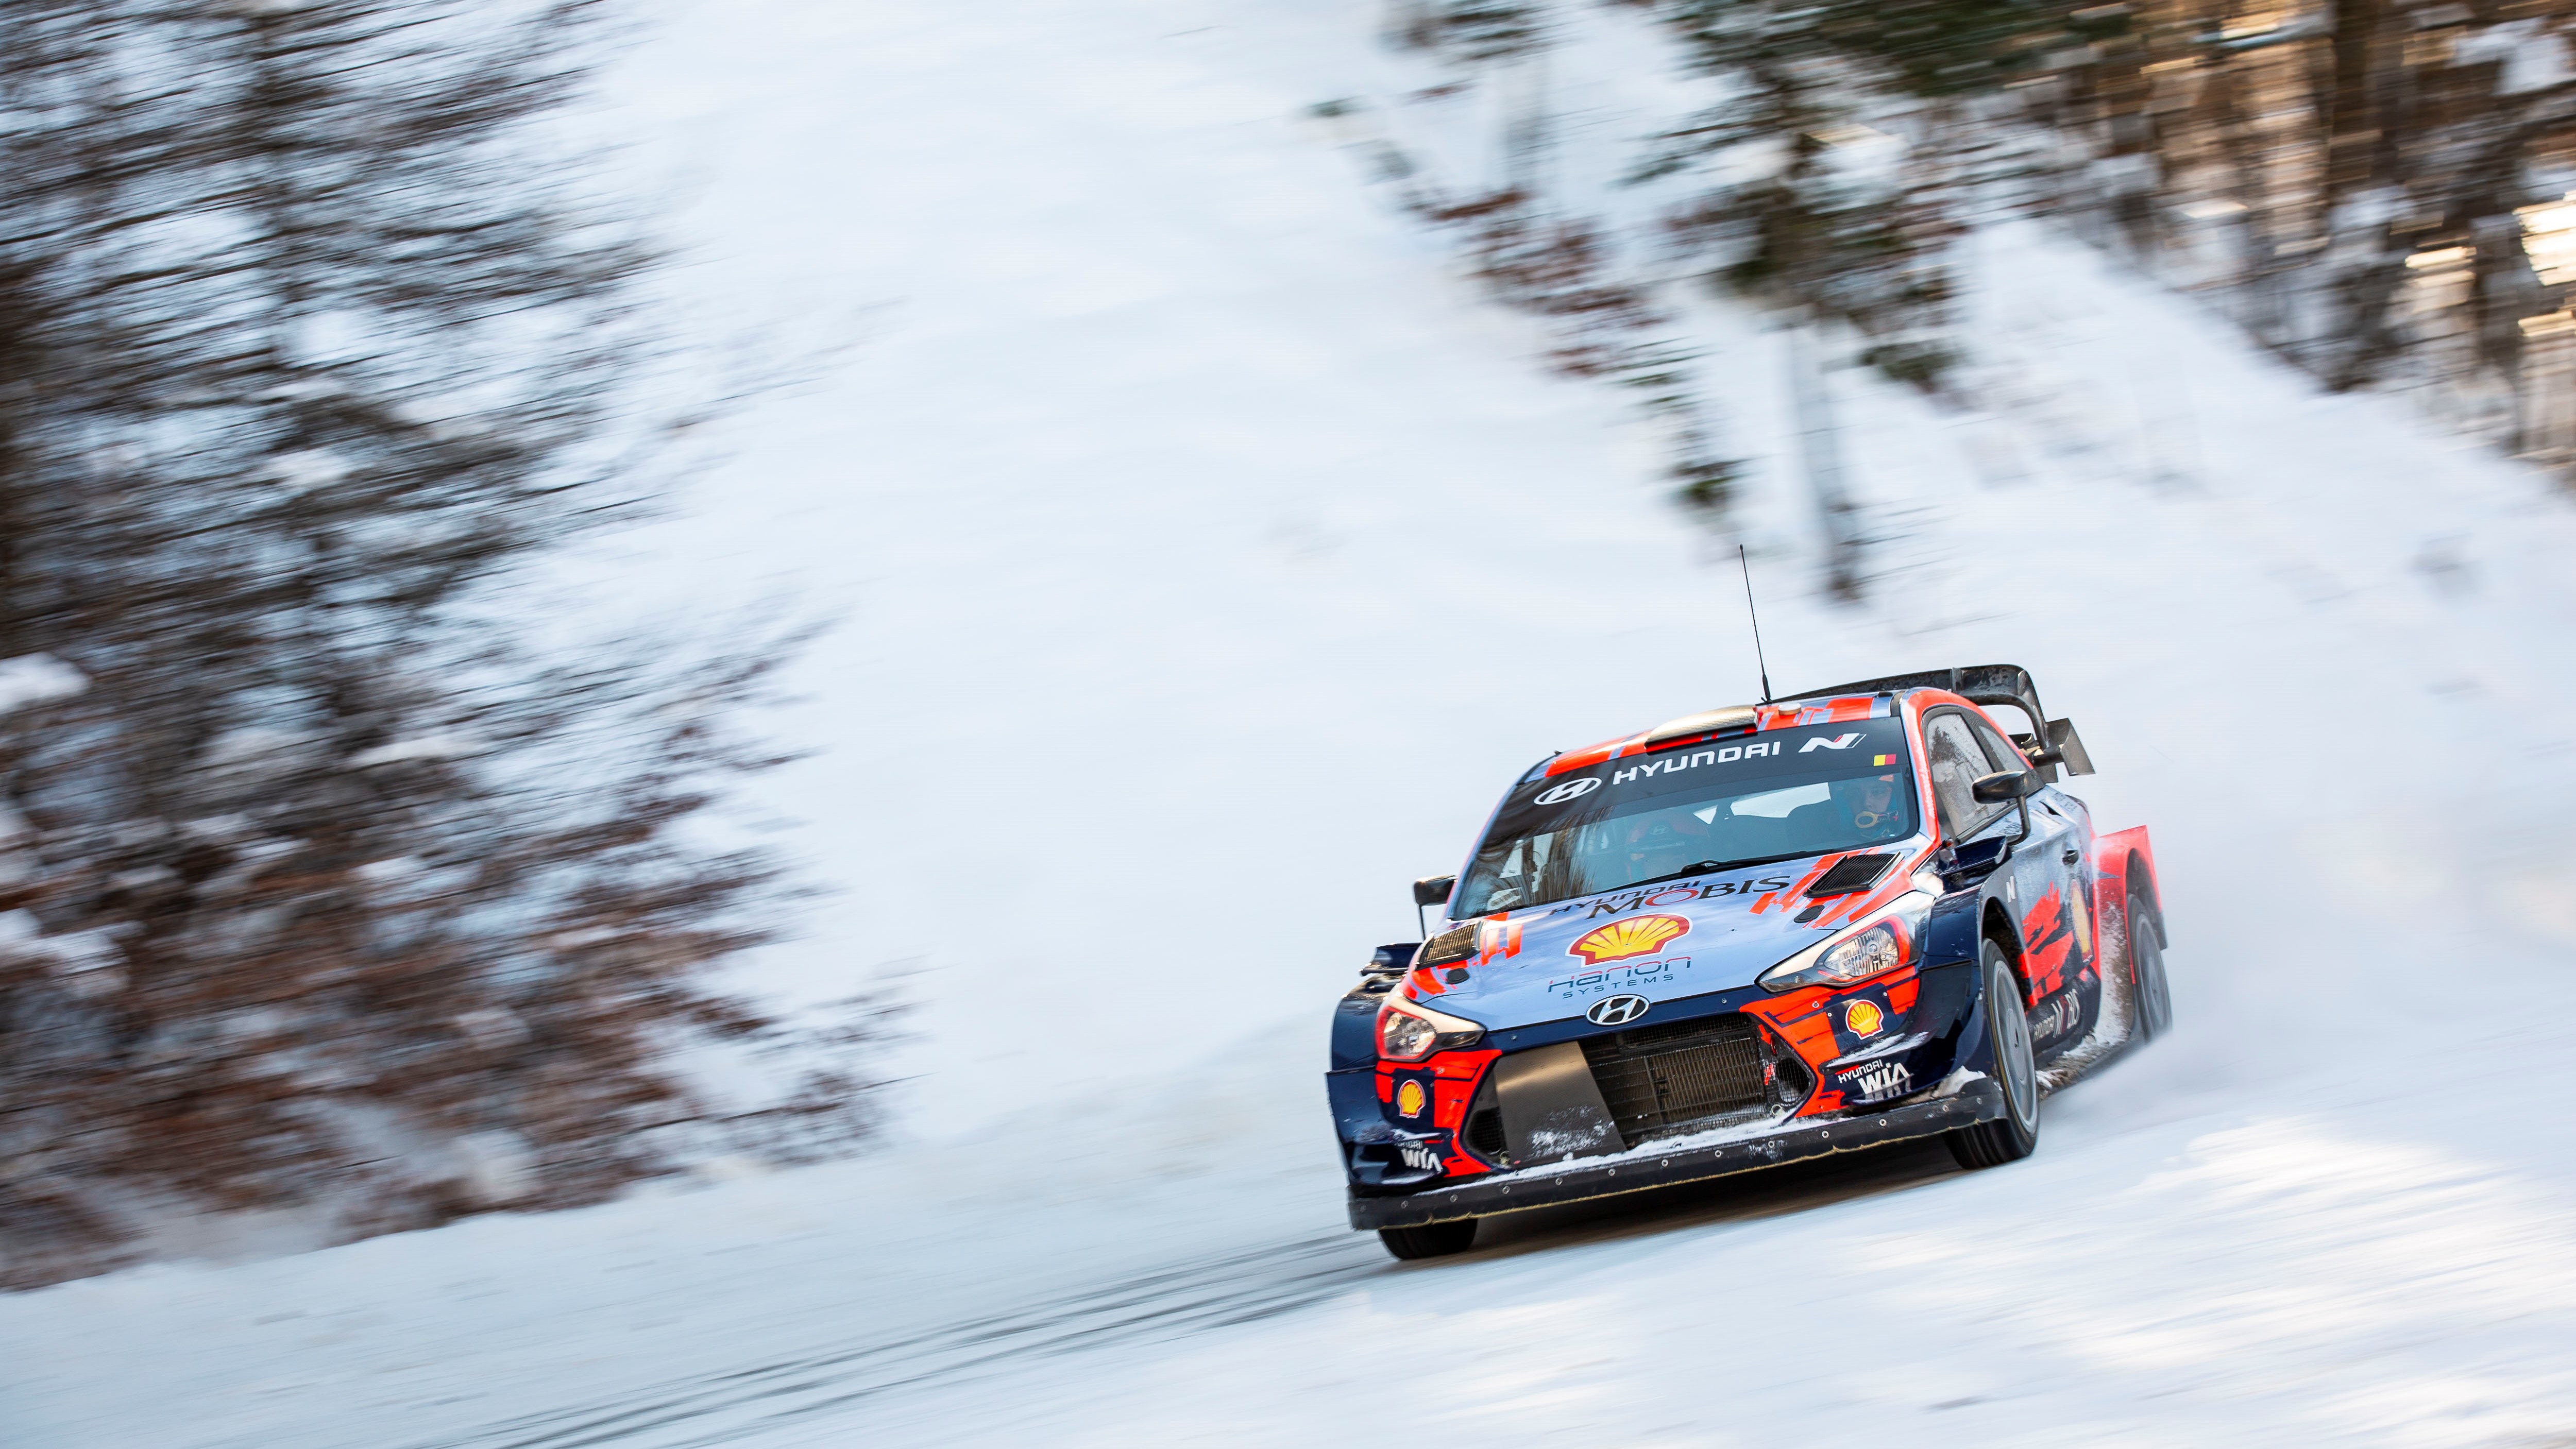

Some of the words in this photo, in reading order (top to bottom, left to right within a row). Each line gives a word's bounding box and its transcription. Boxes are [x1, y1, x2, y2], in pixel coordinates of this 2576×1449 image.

[1613, 741, 1781, 785] HYUNDAI
[1549, 880, 1701, 915] HYUNDAI
[1585, 876, 1791, 919] MOBIS
[1563, 974, 1674, 999] SYSTEMS
[1838, 1059, 1883, 1084] HYUNDAI
